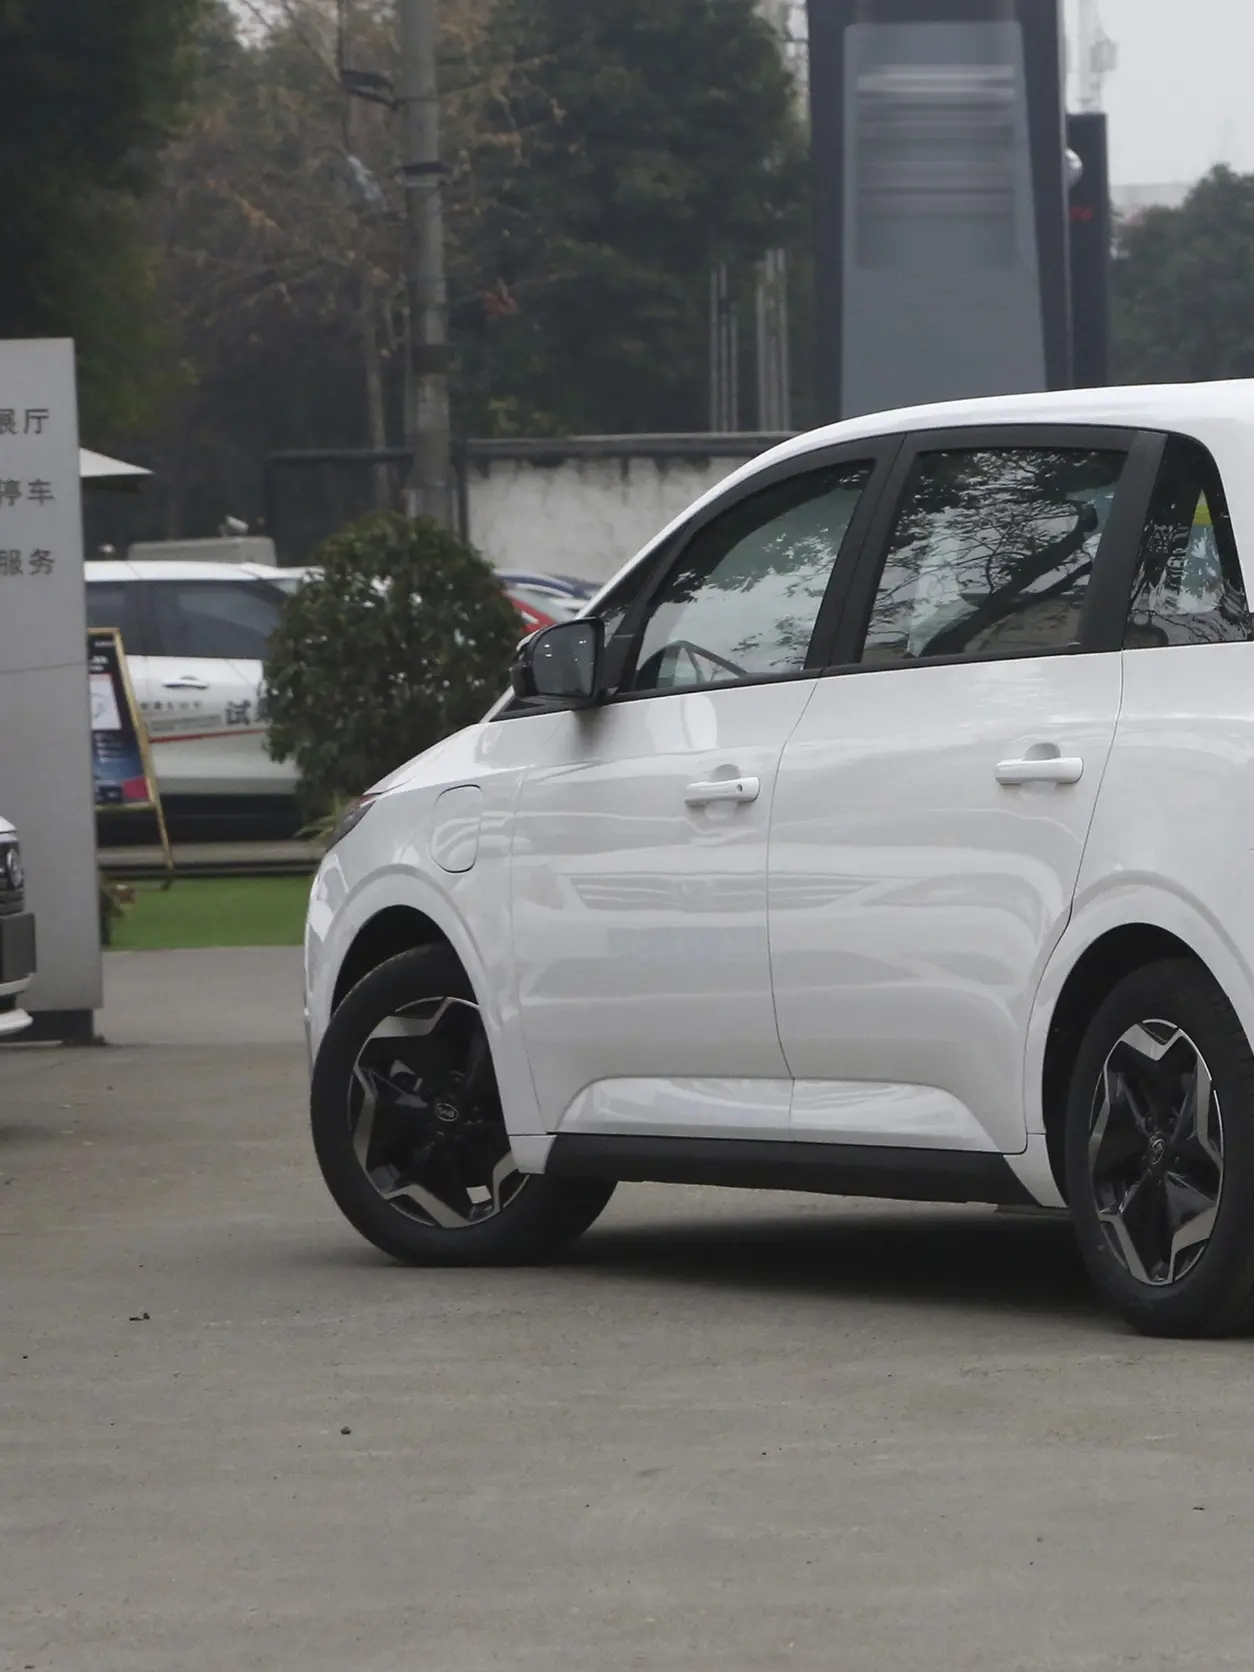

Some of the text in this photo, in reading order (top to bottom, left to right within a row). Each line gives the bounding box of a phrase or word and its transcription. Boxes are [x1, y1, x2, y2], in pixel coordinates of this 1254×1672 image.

[0, 408, 49, 435] 展厅
[0, 479, 55, 507] 停车
[0, 549, 54, 576] 服务
